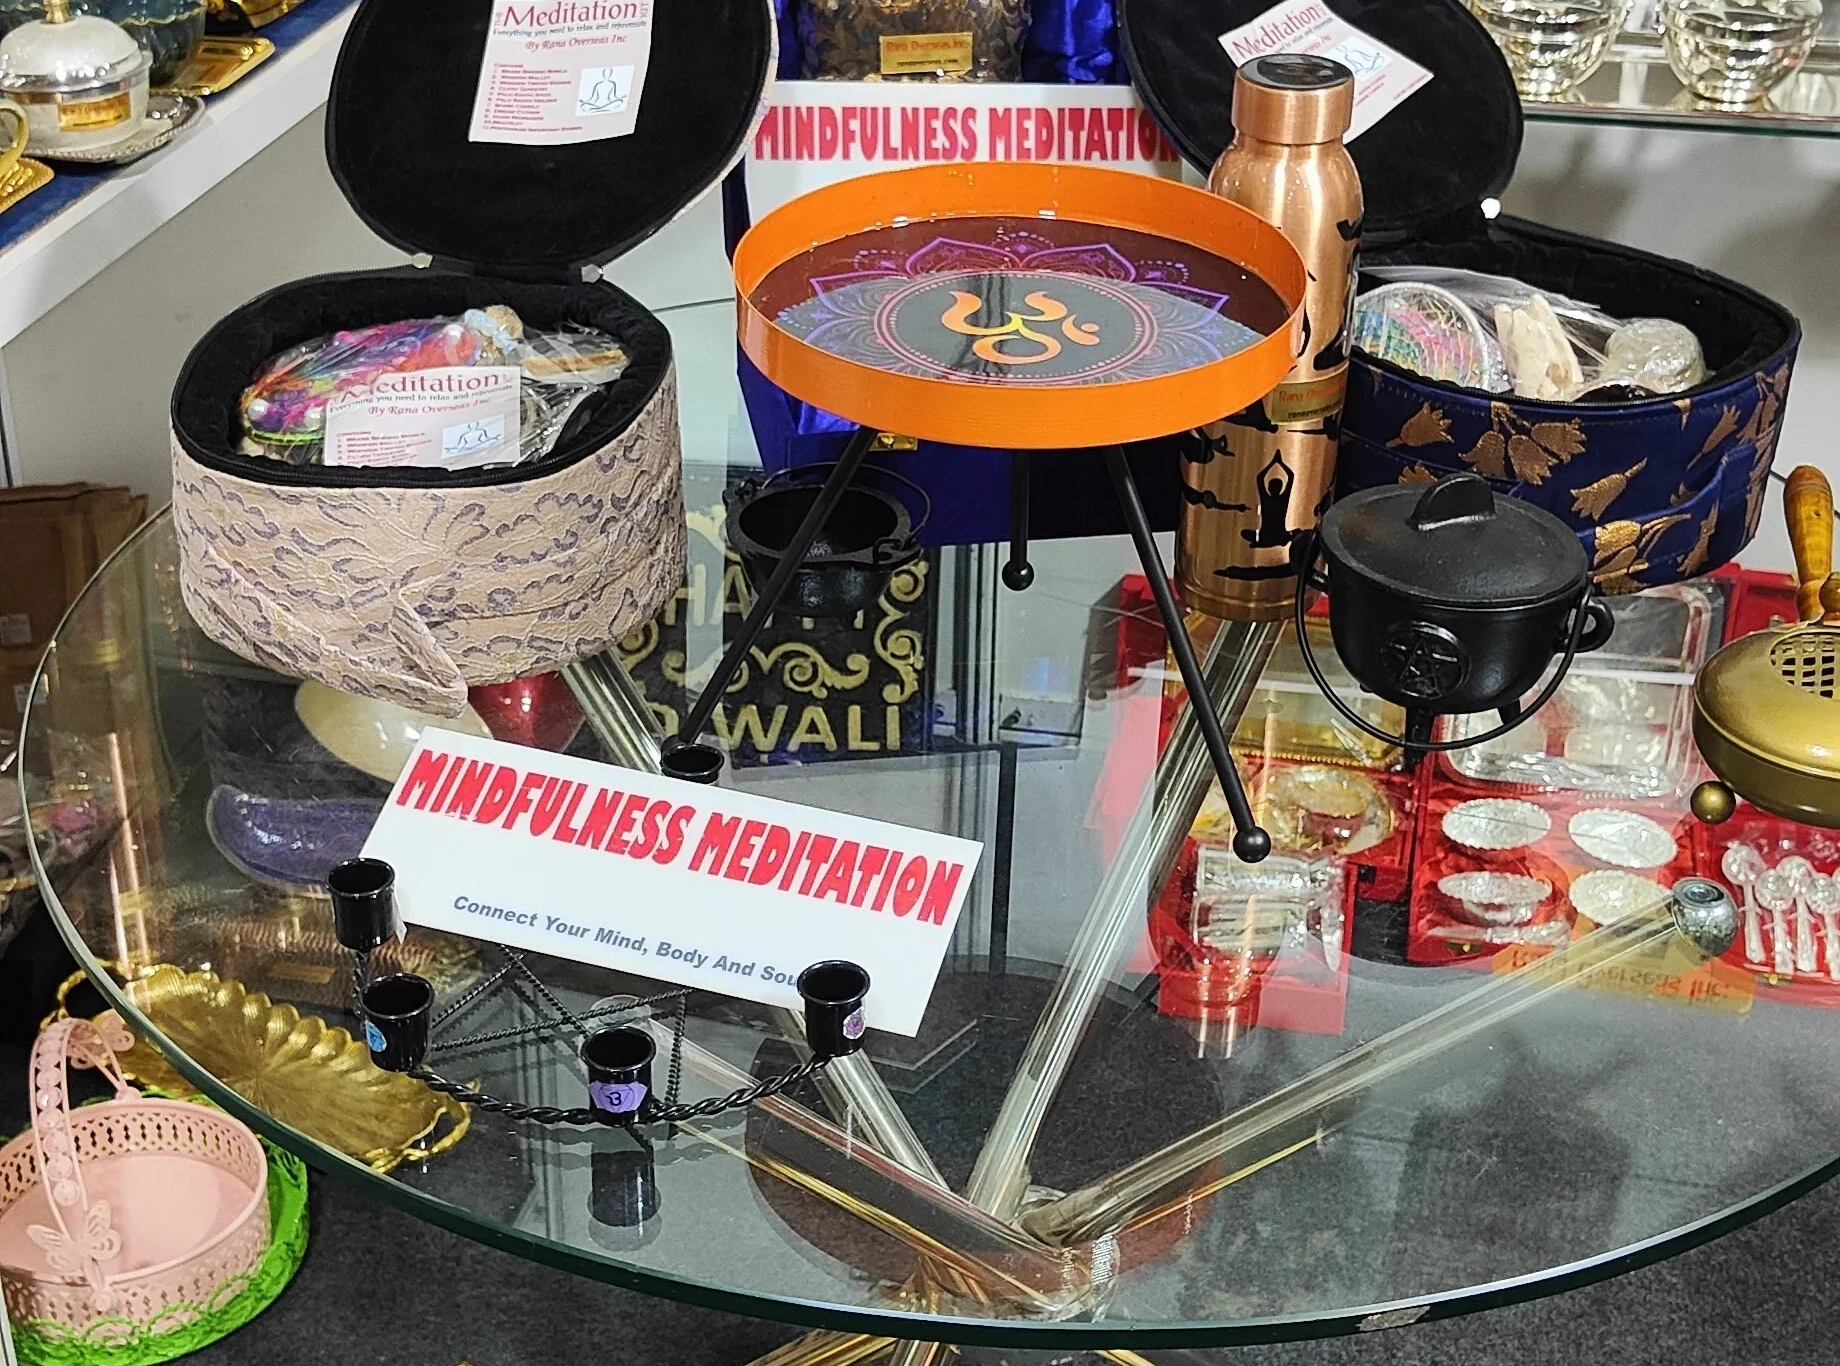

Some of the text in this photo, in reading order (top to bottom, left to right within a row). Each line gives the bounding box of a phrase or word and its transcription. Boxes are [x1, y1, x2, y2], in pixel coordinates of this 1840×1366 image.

[504, 0, 638, 27] Meditation
[1232, 6, 1320, 59] Meditation
[541, 38, 565, 50] Rana
[569, 36, 609, 47] Overseas
[755, 106, 977, 162] MINDFULNESS
[388, 405, 419, 415] Rana
[396, 749, 964, 925] MINDFULNESS MEDITATION
[453, 895, 797, 987] Connect Your Mind, Body And Sou
